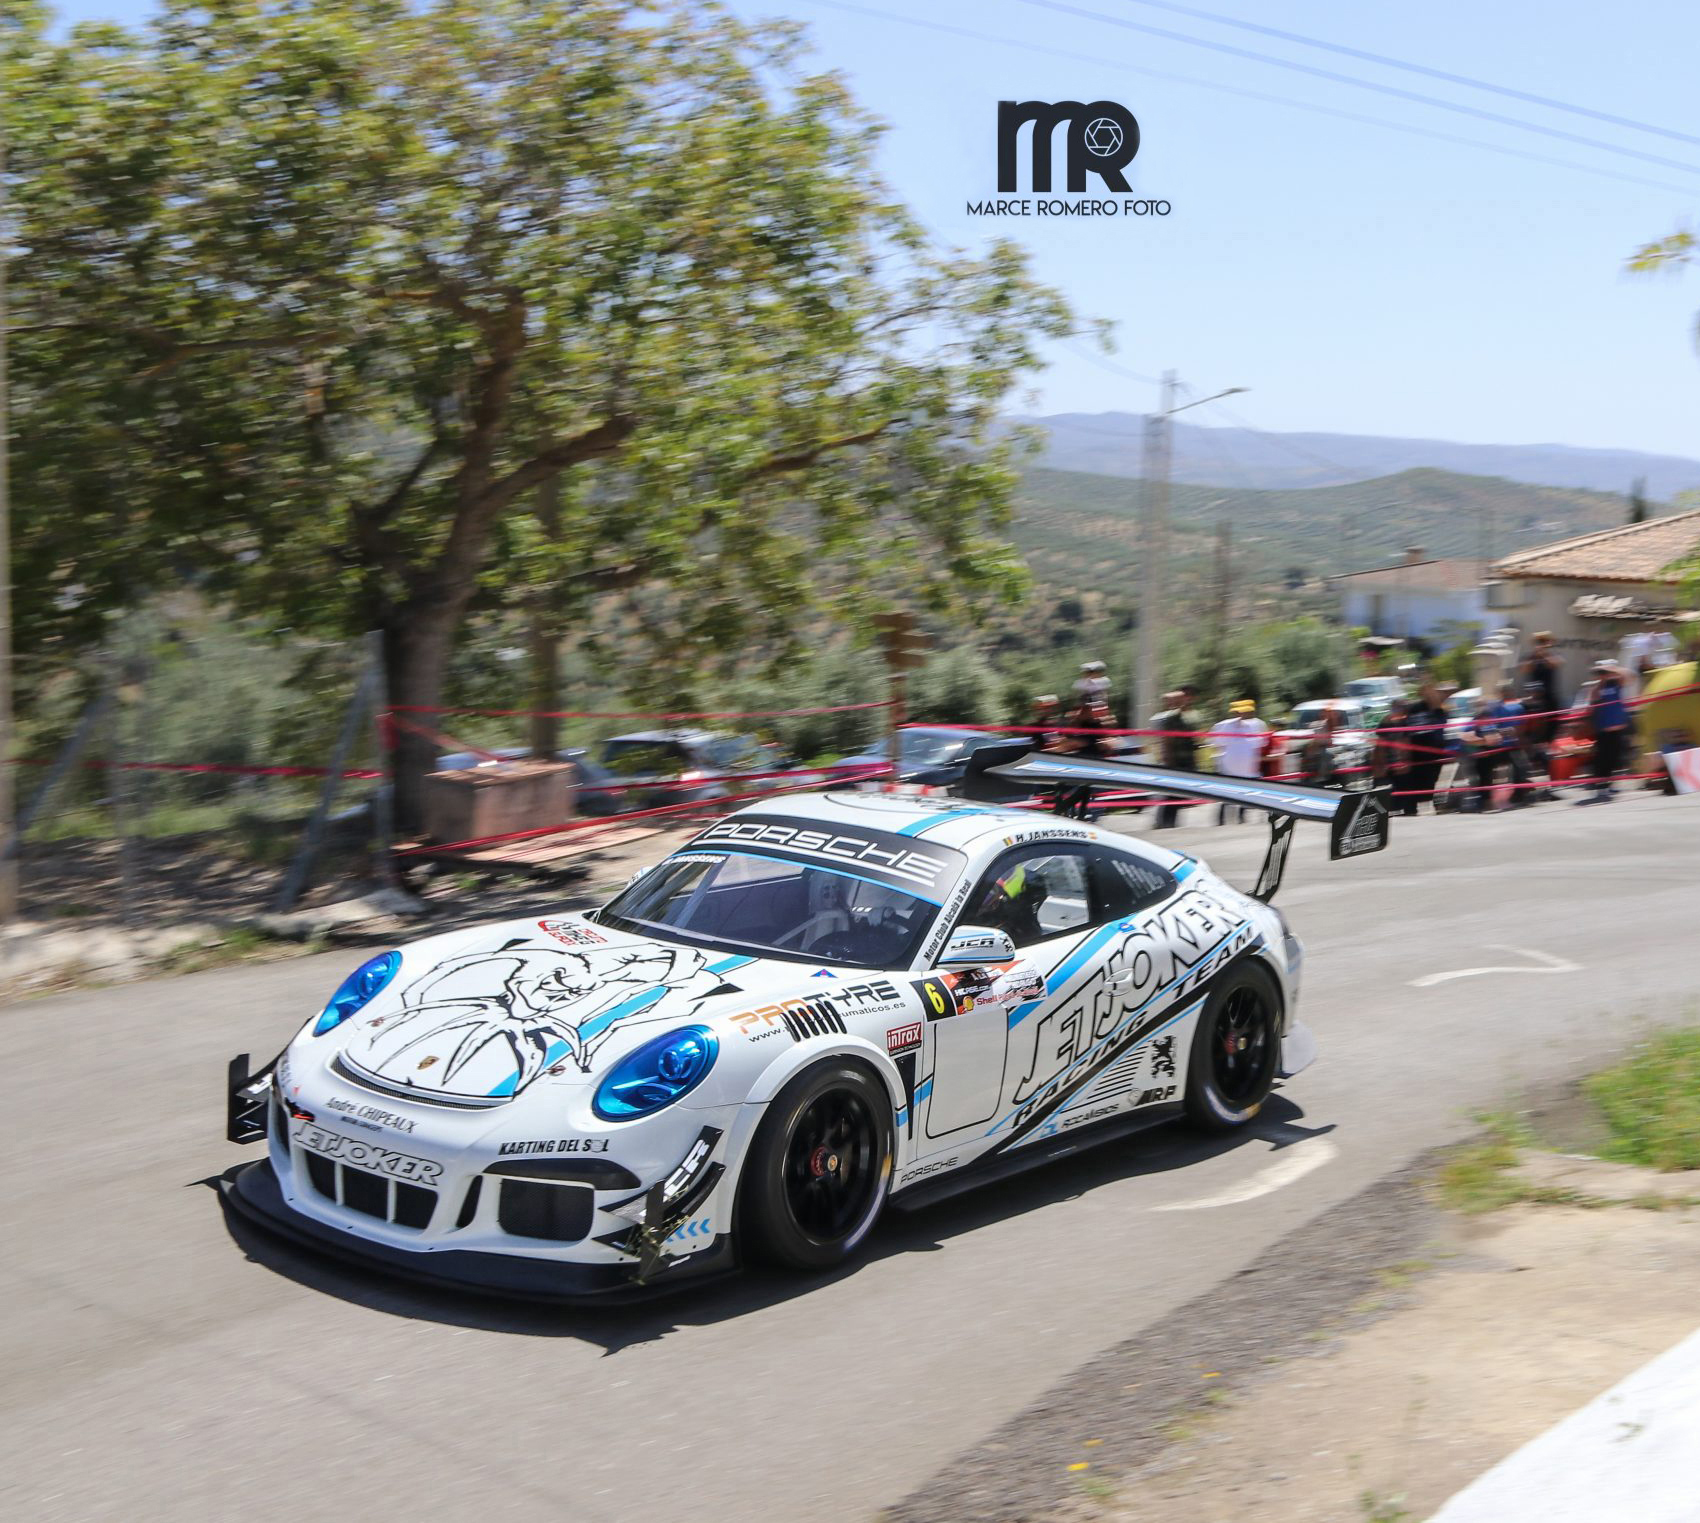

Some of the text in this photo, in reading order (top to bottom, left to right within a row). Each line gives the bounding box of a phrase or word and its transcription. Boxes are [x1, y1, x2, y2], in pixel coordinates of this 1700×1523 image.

[704, 823, 948, 879] PORSCHE
[923, 938, 940, 962] Motor
[935, 922, 949, 941] Club
[924, 983, 945, 1014] 6
[976, 994, 999, 1006] Shell
[1011, 926, 1255, 1129] RACING TEAM
[357, 1105, 420, 1134] CHIPEAUX
[293, 1121, 444, 1187] JETJOKER
[498, 1138, 610, 1156] KARTING DEL SL
[901, 1156, 959, 1184] PORSCHE
